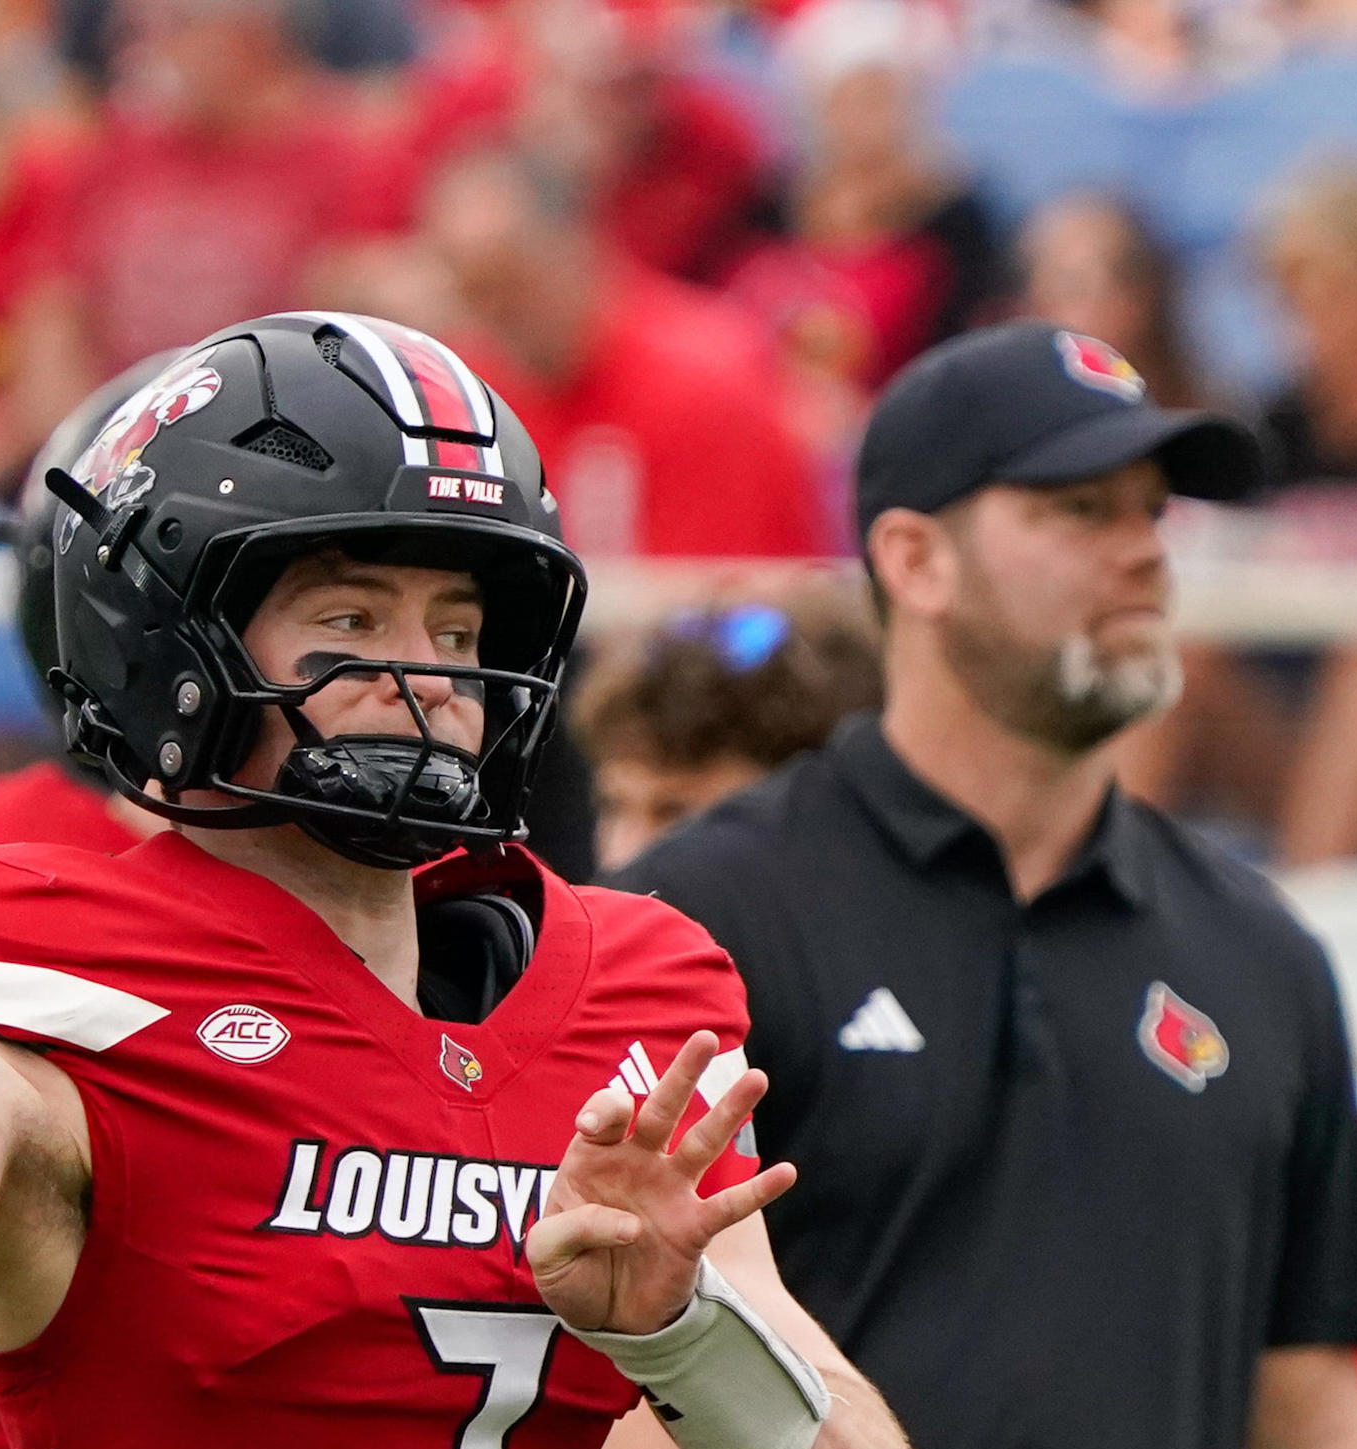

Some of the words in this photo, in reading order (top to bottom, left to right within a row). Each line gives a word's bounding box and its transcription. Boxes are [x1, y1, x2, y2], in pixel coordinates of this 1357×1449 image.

[428, 475, 462, 498] THE
[463, 479, 504, 505] VILLE
[213, 1021, 274, 1039] ACC
[268, 1140, 559, 1250] LOUISV
